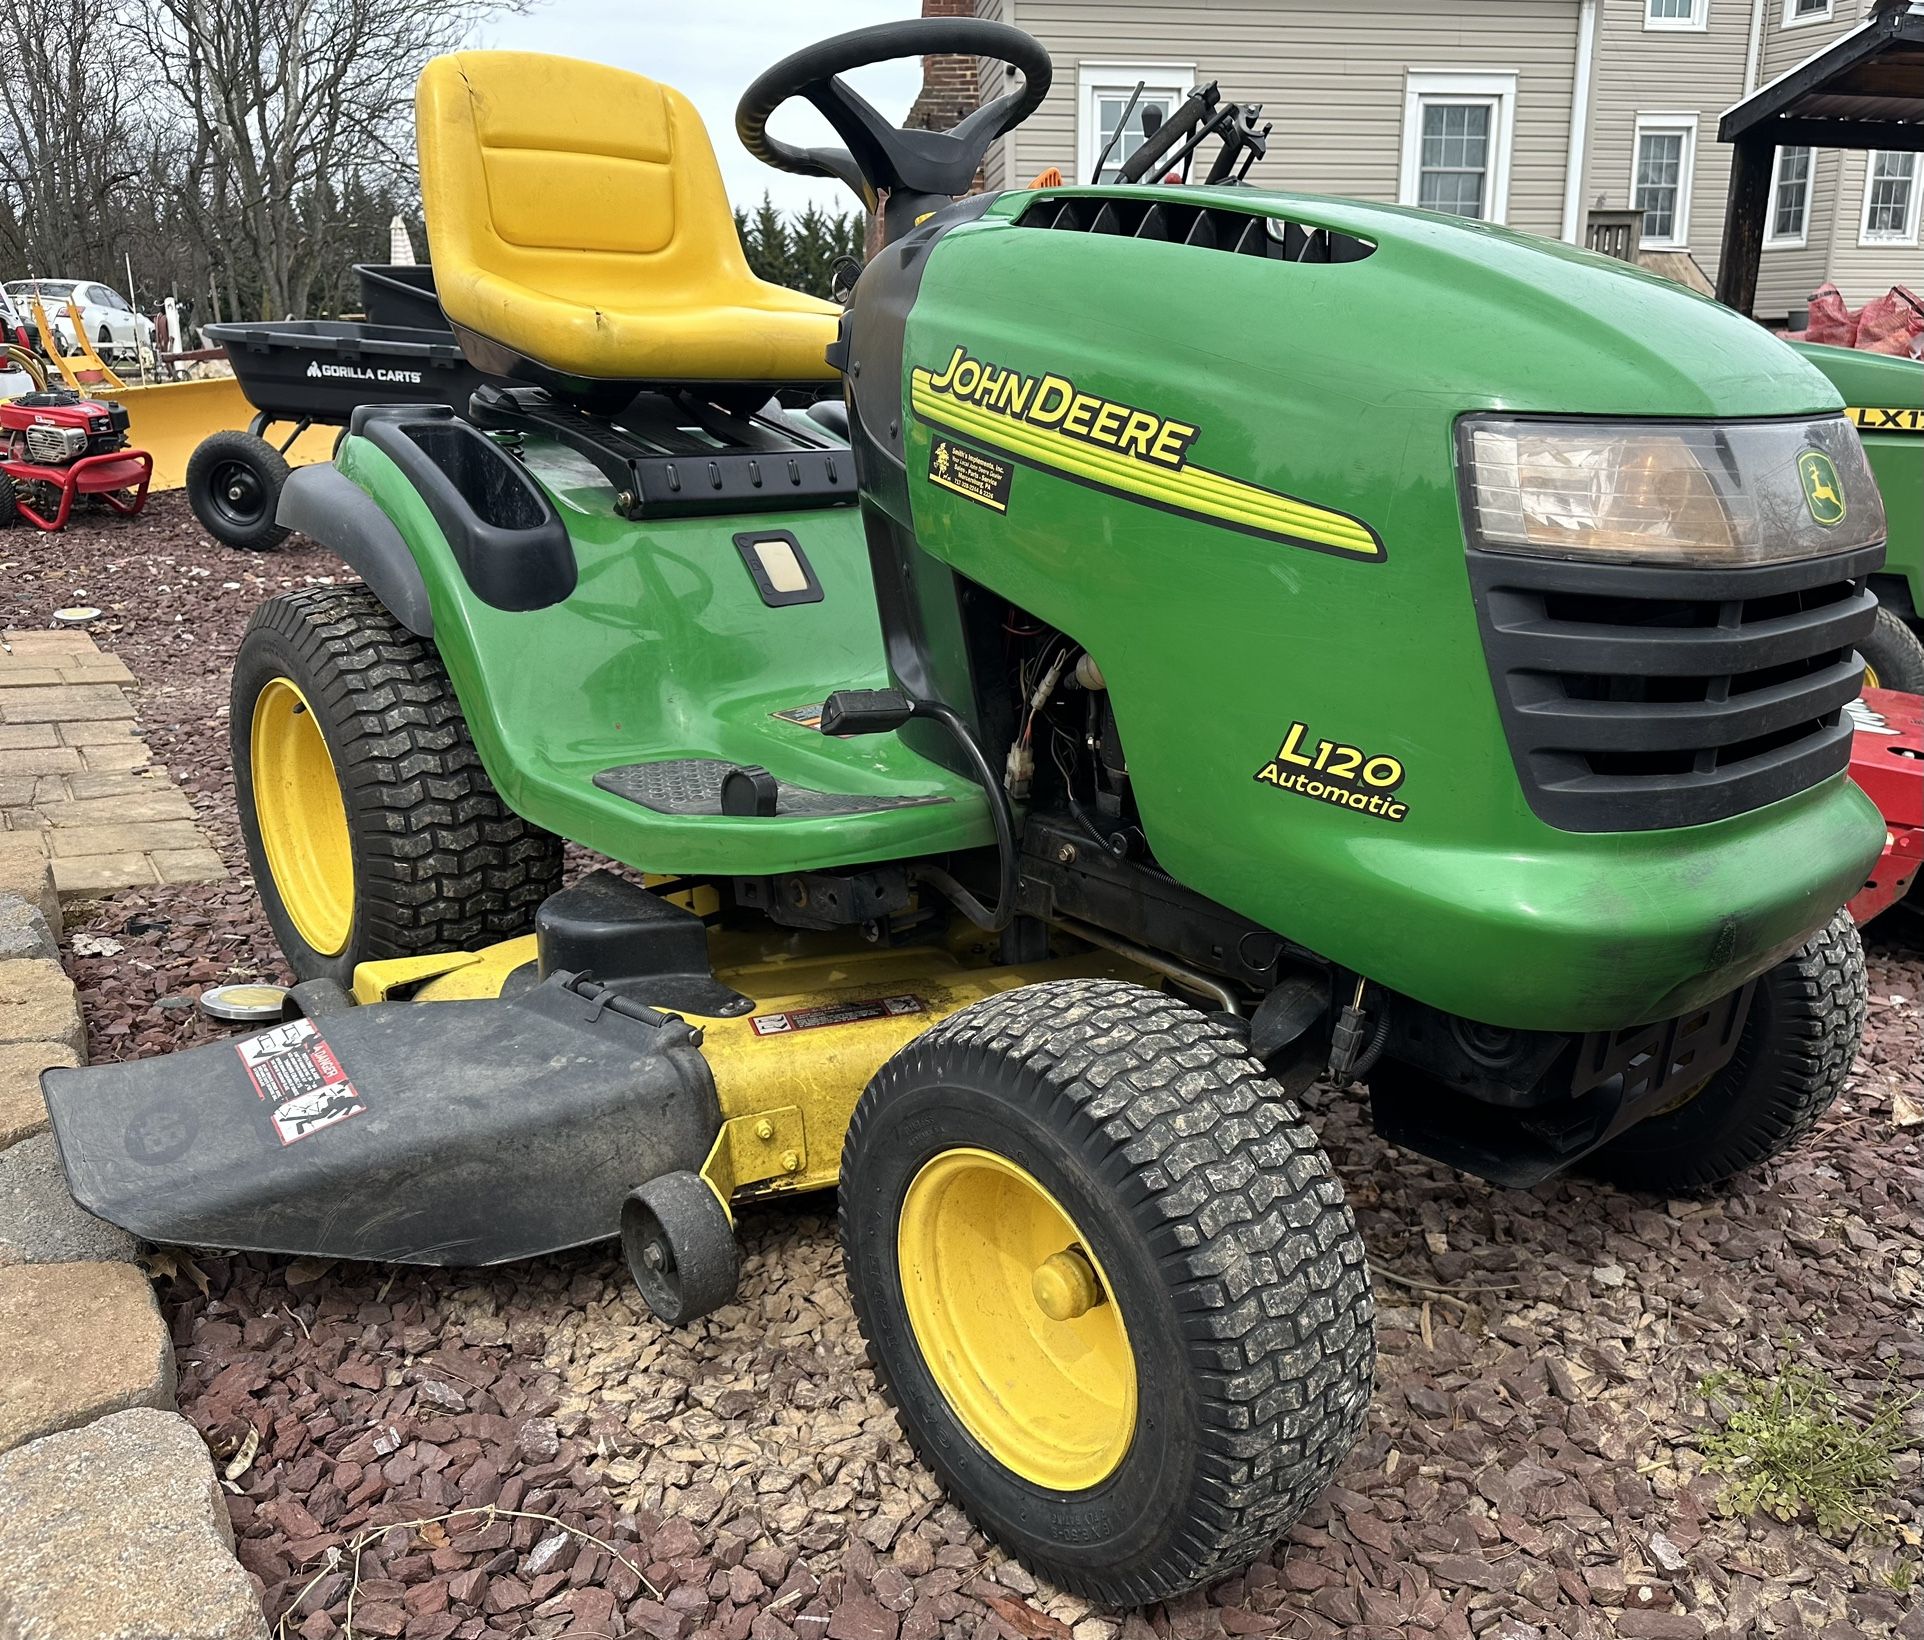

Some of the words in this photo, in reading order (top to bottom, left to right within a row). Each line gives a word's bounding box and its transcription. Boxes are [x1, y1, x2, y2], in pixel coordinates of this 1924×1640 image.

[321, 364, 375, 380] GORILLA
[377, 369, 421, 384] CARTS
[930, 346, 1034, 414] JOHN
[1027, 375, 1195, 465] DEERE
[1857, 409, 1924, 428] LX1
[984, 482, 992, 491] PA
[1278, 723, 1402, 787] L120
[1257, 763, 1406, 819] Automatic
[315, 1048, 338, 1078] DANGER
